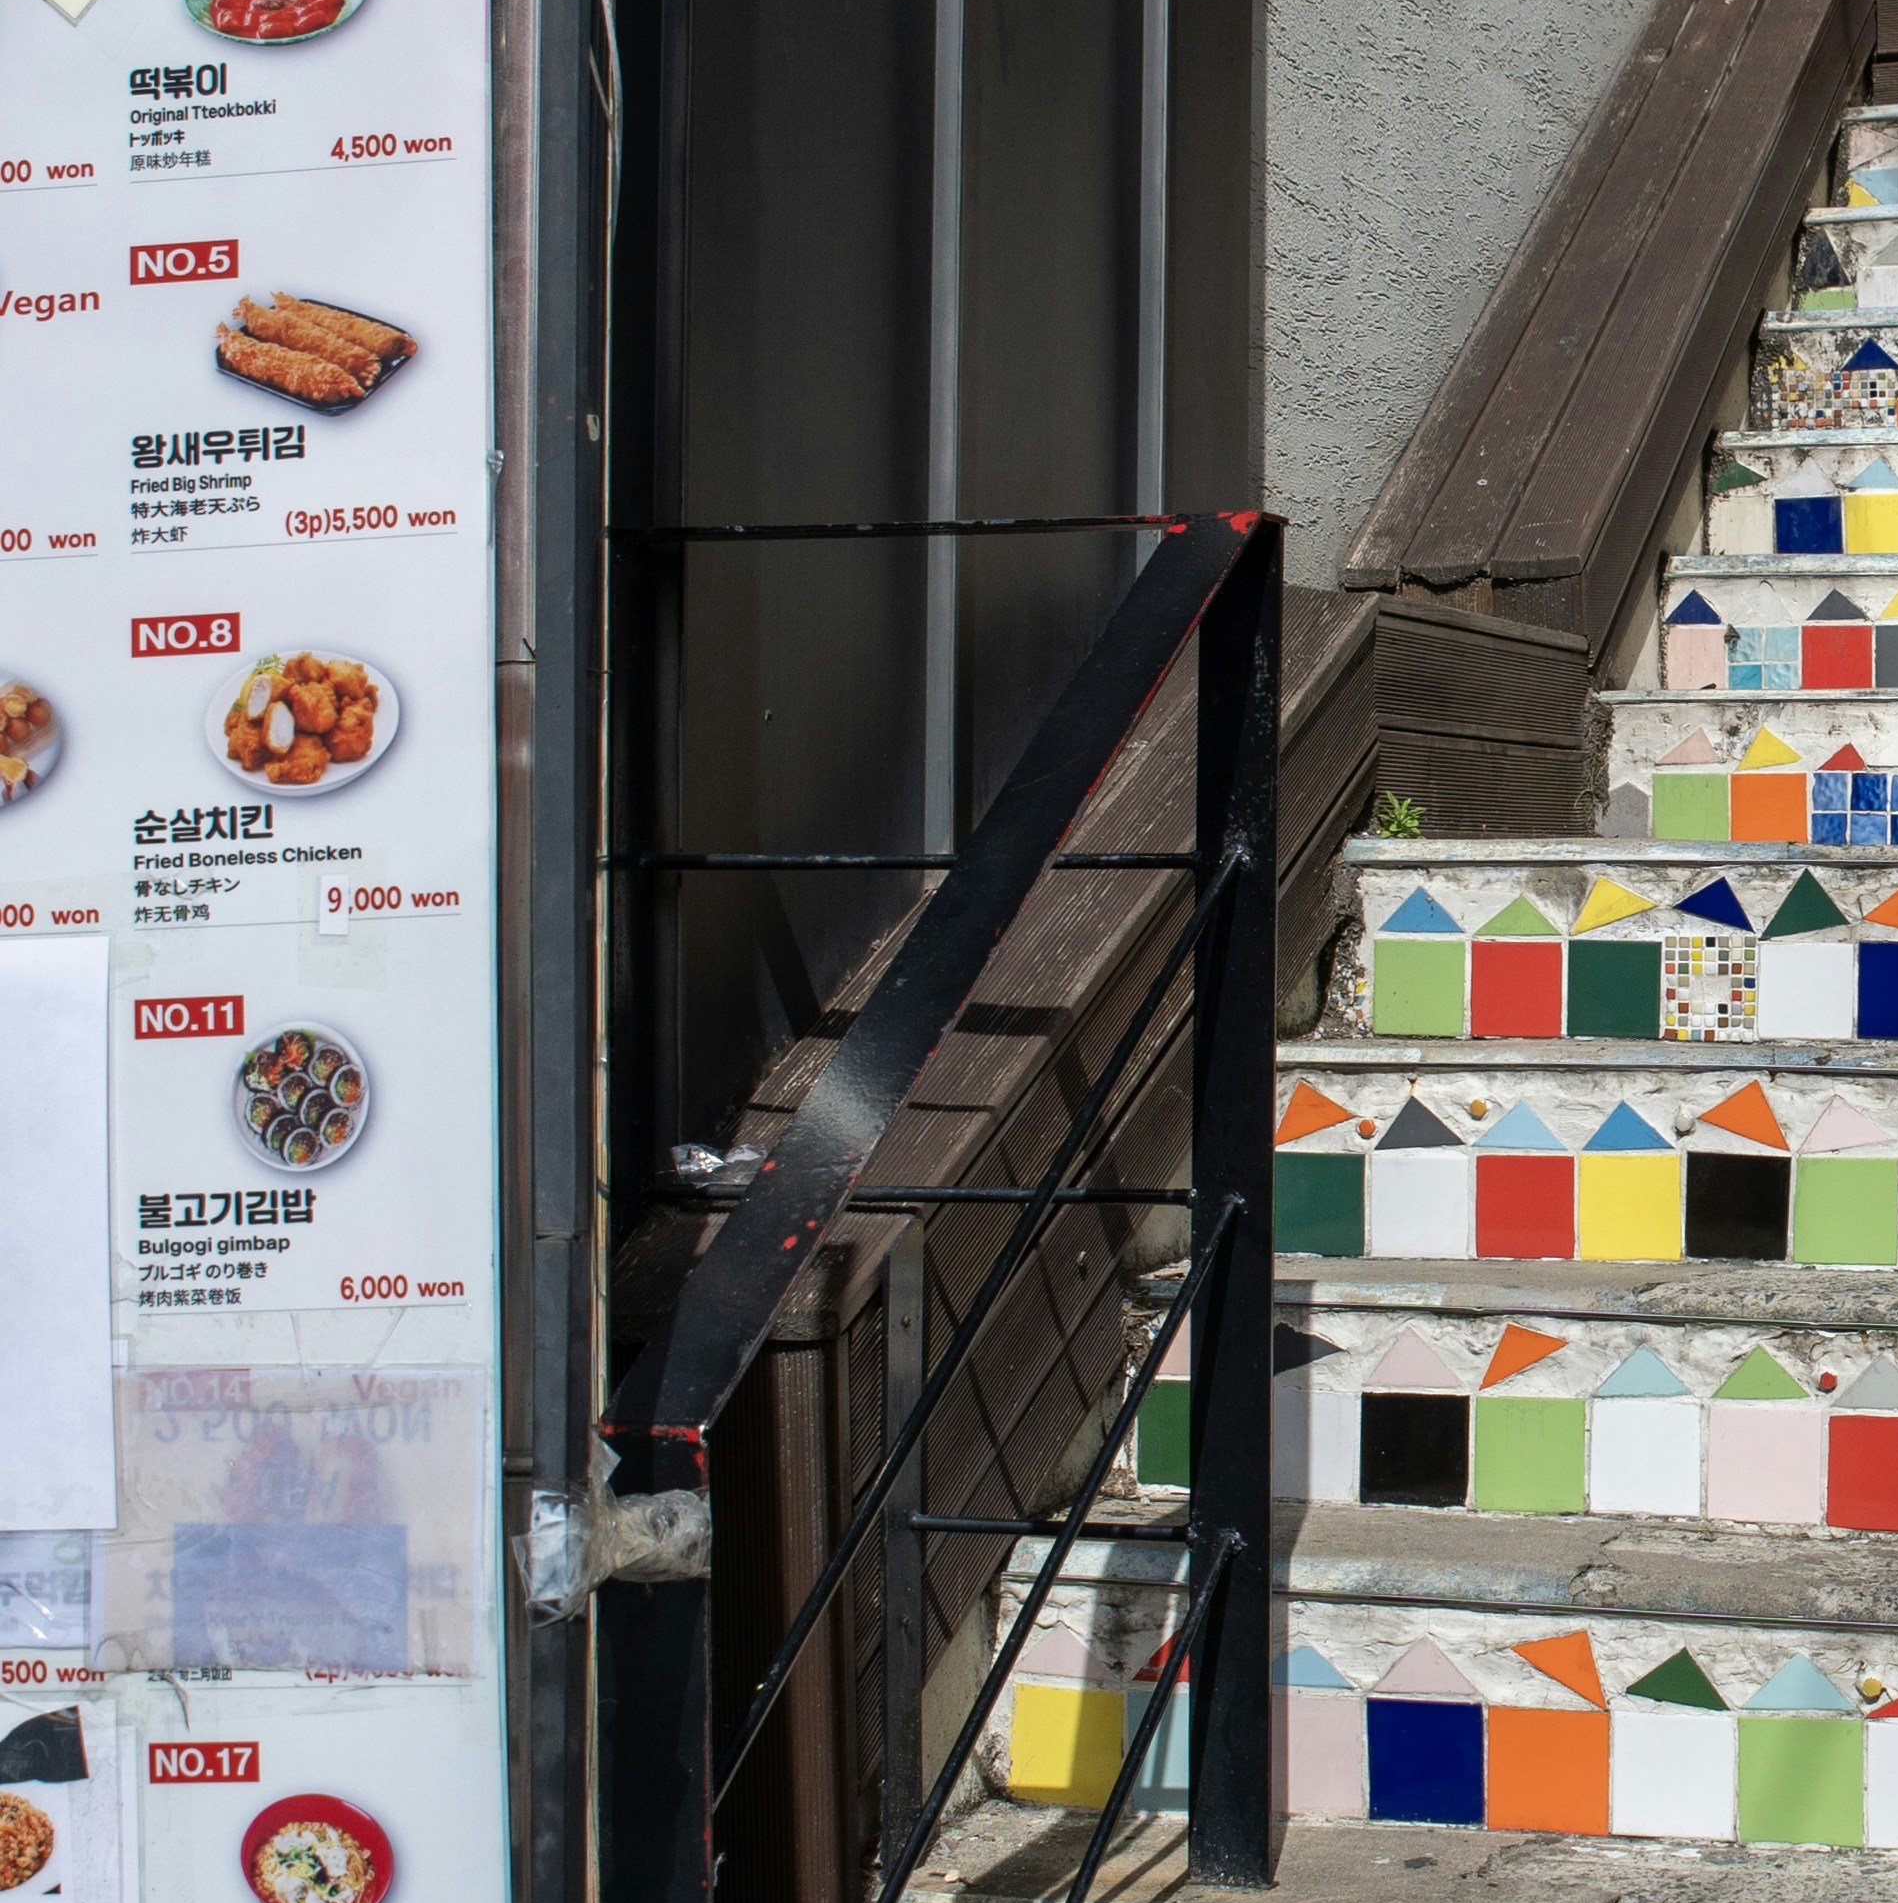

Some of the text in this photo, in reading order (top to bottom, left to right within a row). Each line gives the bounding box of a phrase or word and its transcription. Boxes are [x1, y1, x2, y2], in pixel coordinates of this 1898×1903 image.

[130, 62, 227, 100] 떡볶이
[130, 100, 276, 126] Original Tteokbokki
[130, 130, 185, 148] トッポッキ
[330, 133, 452, 162] 4,500 won
[46, 161, 94, 180] won
[130, 150, 211, 171] 原味炒年糕
[137, 245, 232, 279] NO.5
[131, 425, 306, 468] 왕새우튀김
[131, 473, 252, 496] Fried Big Shrimp
[131, 496, 261, 520] 特大海老天ぷら
[285, 505, 456, 538] (3p)5,500 won
[49, 530, 96, 549] won
[131, 525, 188, 545] 炸大虾
[138, 618, 233, 652] NO.8
[134, 804, 273, 844] 순살치킨
[134, 844, 361, 870] Fried Boneless Chicken
[134, 877, 240, 897] 骨なしチキン
[327, 886, 459, 914] 9,000 won
[52, 906, 99, 925] won
[134, 905, 210, 924] 炸无骨鸡
[140, 1001, 236, 1034] NO.11
[139, 1188, 316, 1229] 불고기김밥
[139, 1234, 290, 1257] Bulgogi gimbap
[139, 1261, 269, 1282] ブルゴギ のり巻き
[139, 1288, 242, 1307] 烤肉紫菜卷饭
[340, 1275, 464, 1303] 6,000 won
[2, 1660, 47, 1684] 500
[155, 1747, 253, 1778] NO.17
